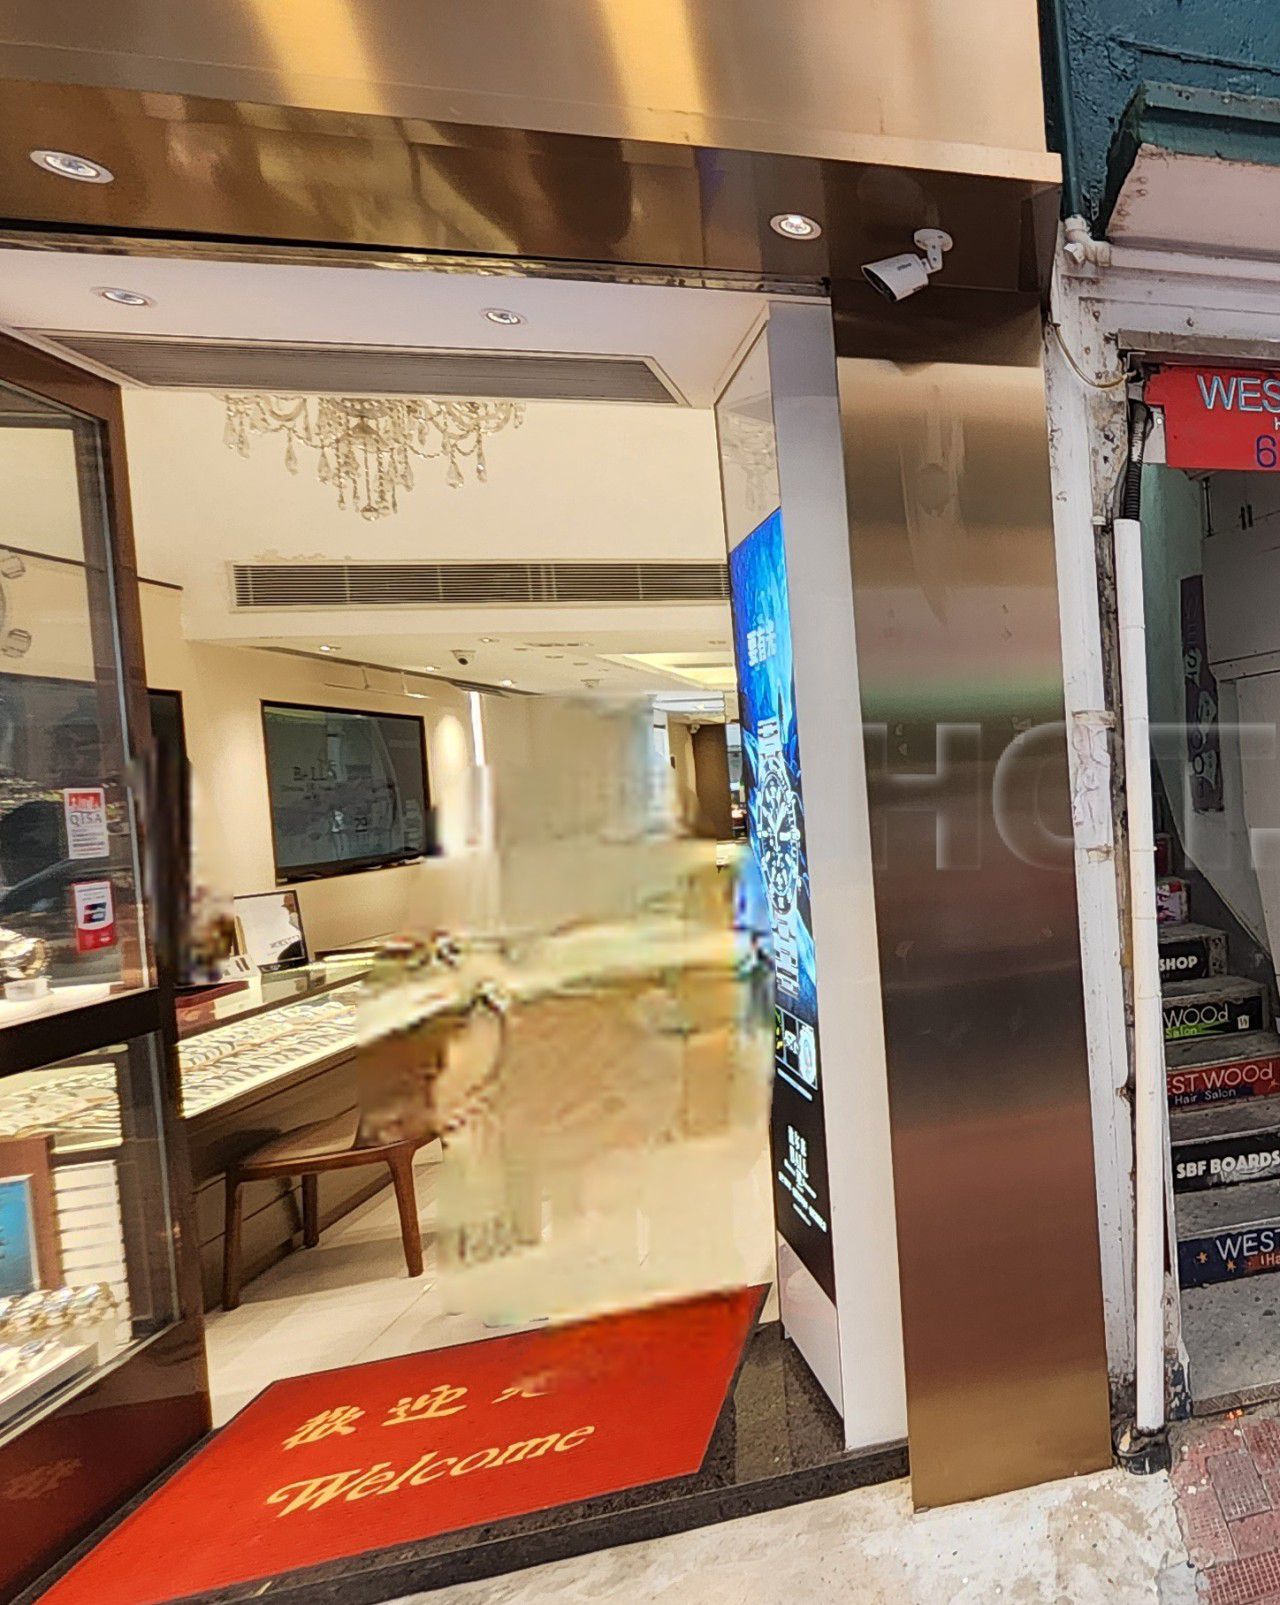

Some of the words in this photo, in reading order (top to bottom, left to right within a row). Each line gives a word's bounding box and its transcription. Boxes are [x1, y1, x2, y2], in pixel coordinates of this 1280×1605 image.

[1202, 1062, 1273, 1089] WOOd
[1174, 1094, 1198, 1105] Hair
[1204, 1087, 1237, 1101] Salon
[1176, 1160, 1207, 1179] SBF
[265, 1426, 596, 1519] Welcome
